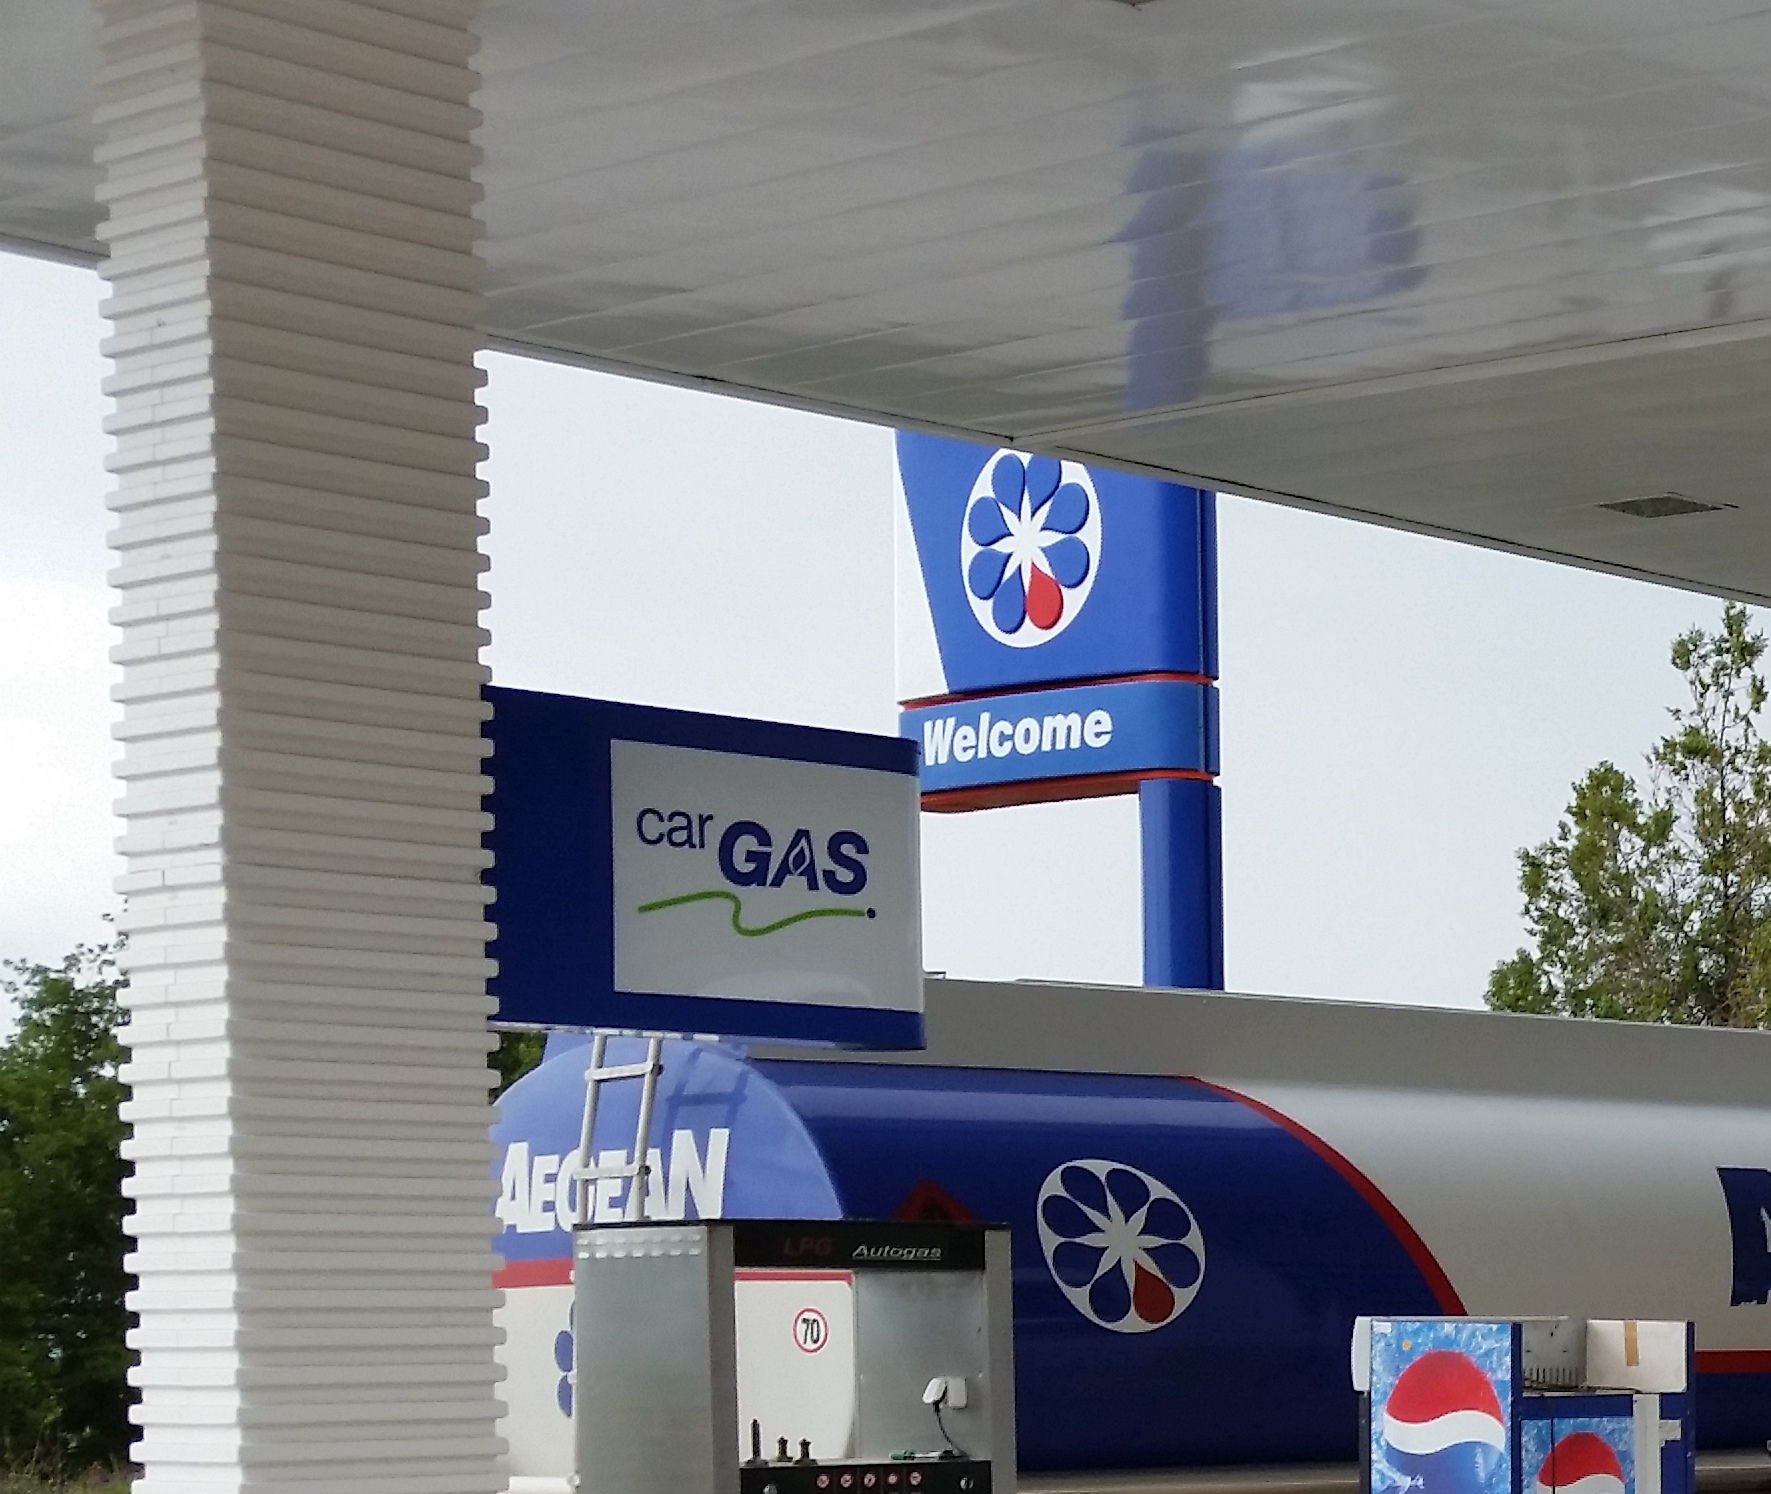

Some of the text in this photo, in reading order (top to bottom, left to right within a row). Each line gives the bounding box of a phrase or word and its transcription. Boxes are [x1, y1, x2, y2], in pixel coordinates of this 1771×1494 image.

[923, 709, 1113, 767] Welcome
[636, 807, 870, 895] car GAS
[852, 1243, 942, 1261] Autogas
[801, 1317, 821, 1345] 70
